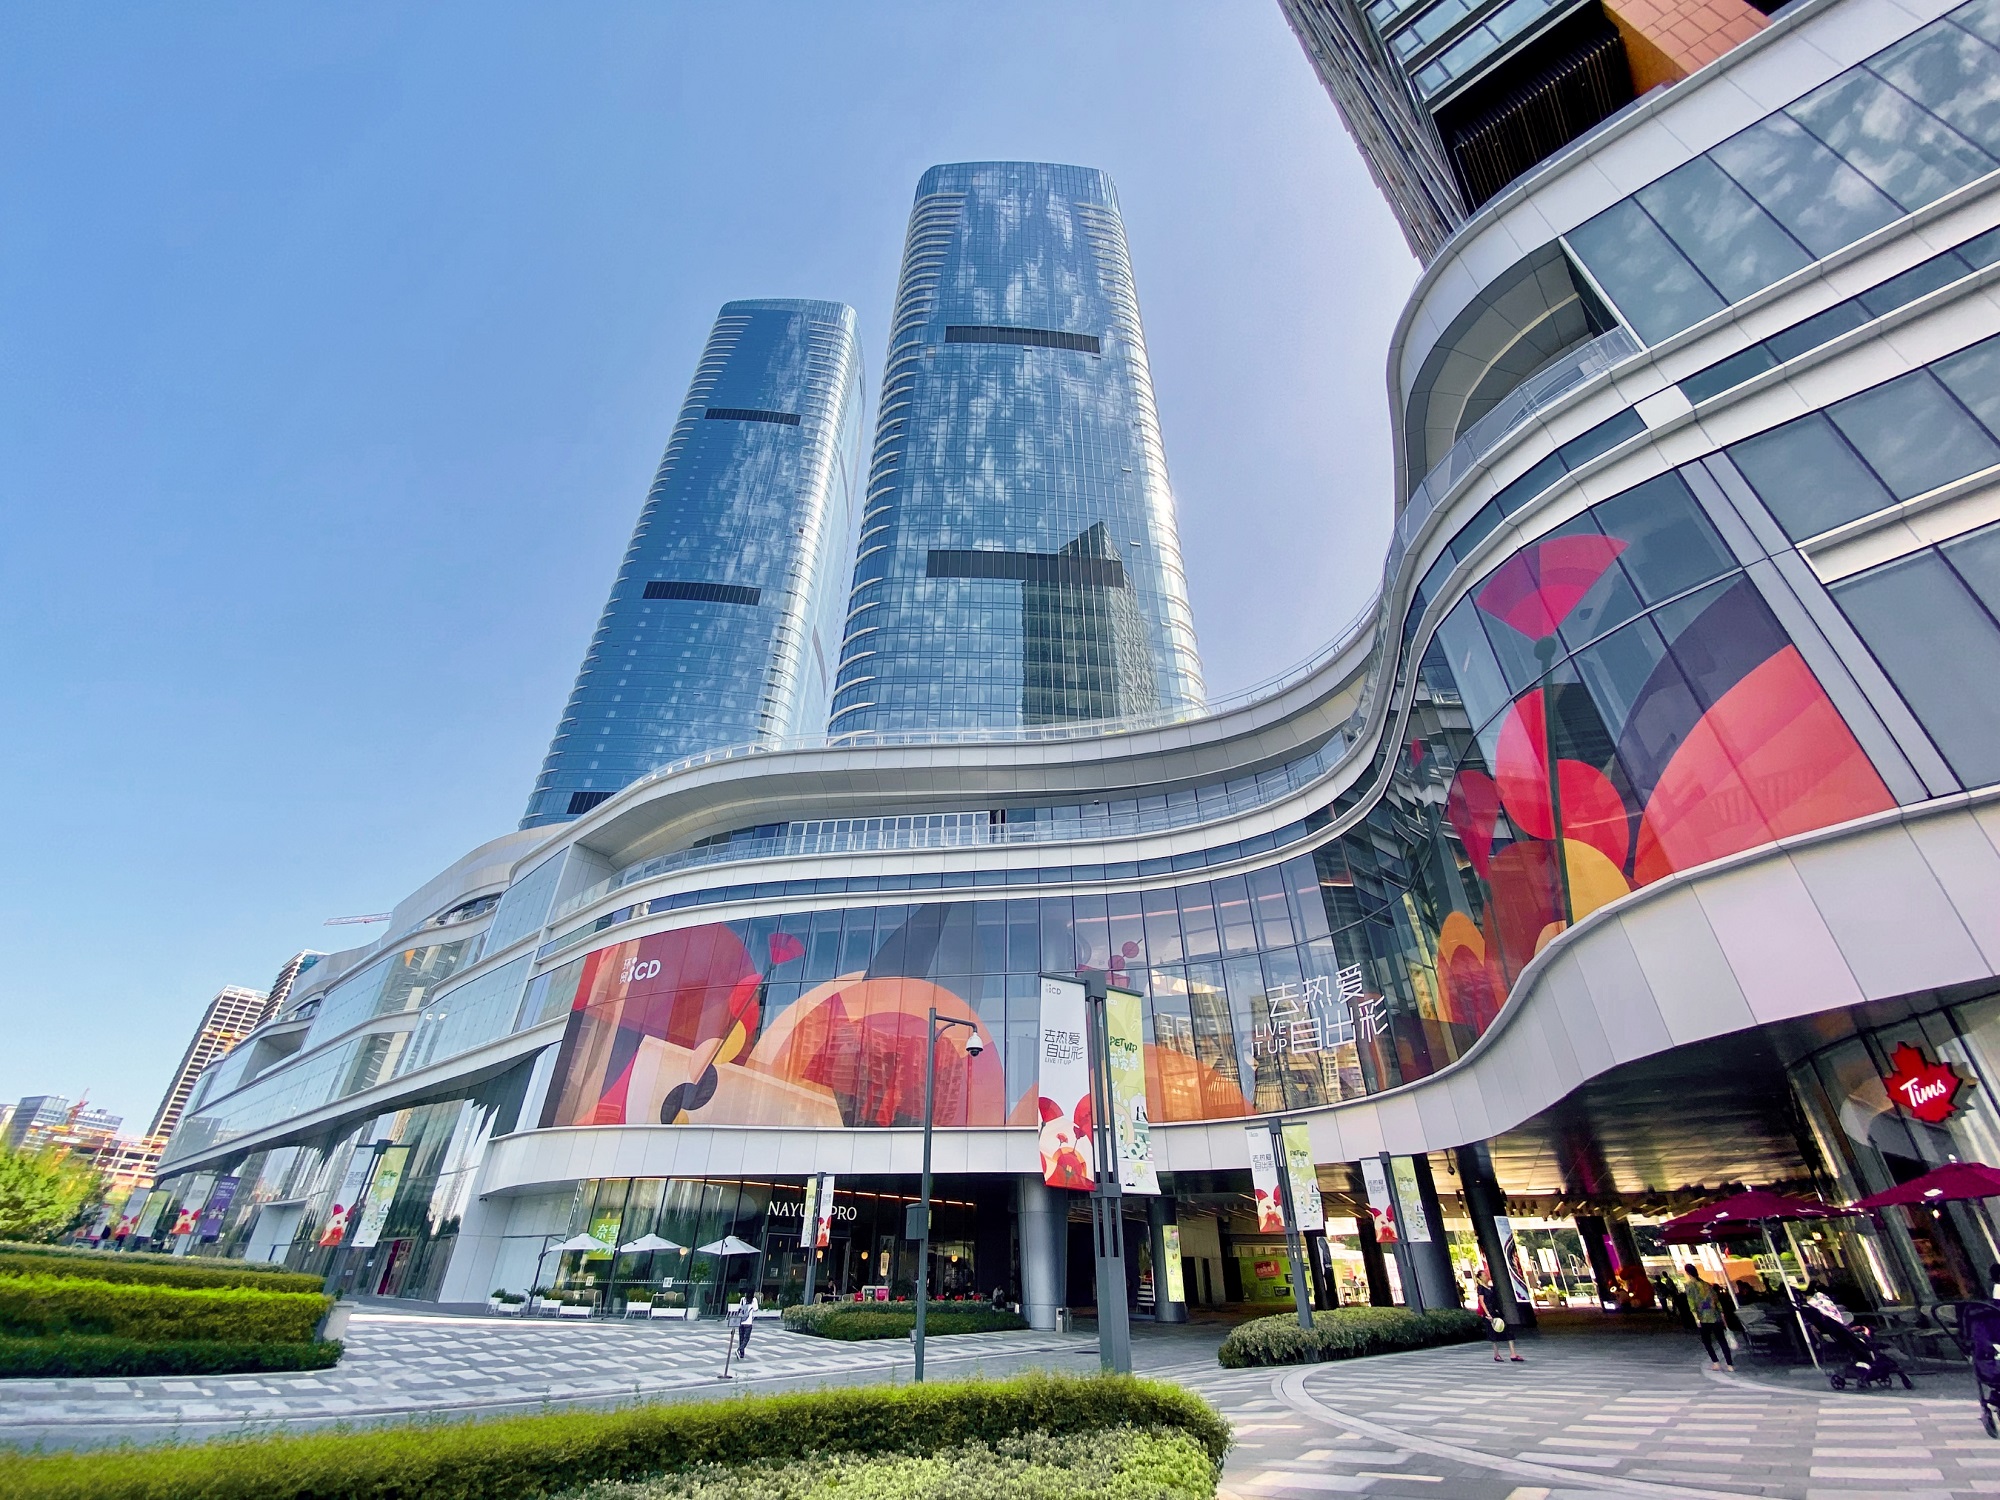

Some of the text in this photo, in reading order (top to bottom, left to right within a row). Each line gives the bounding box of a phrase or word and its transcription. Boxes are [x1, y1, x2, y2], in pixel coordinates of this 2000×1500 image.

[1266, 963, 1364, 1017] 去热爱
[1255, 1021, 1287, 1039] LIVE
[1291, 995, 1388, 1054] 自出彩
[1044, 1029, 1081, 1046] 去热爱
[1046, 1043, 1084, 1061] 自出彩
[1251, 1038, 1287, 1056] IT UP
[1063, 1058, 1072, 1066] UP
[1899, 1077, 1947, 1107] Tims
[767, 1200, 806, 1218] NAYU
